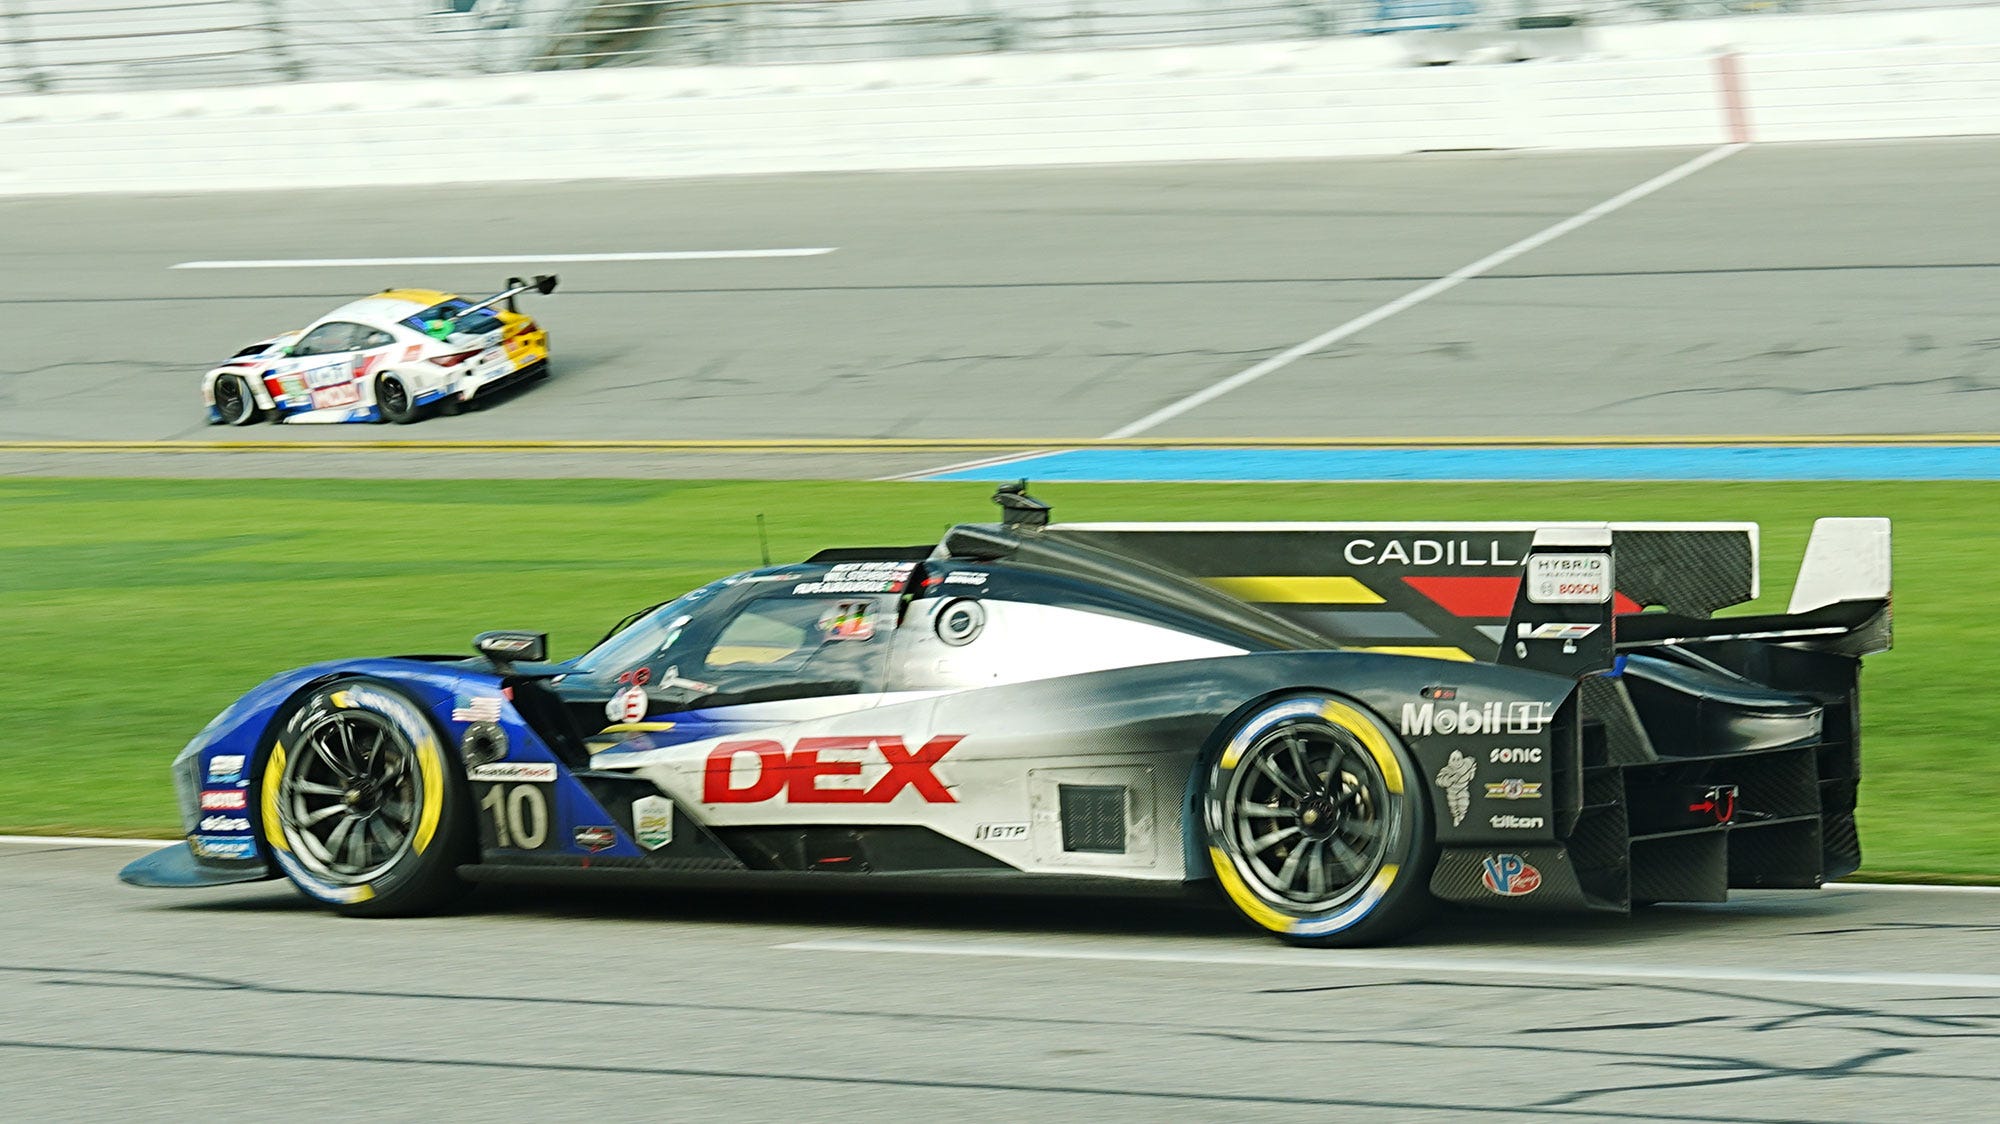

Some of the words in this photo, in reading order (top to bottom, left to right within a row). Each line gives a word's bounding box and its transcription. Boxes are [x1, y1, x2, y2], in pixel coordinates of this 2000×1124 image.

[1343, 539, 1530, 566] CADILL
[1559, 583, 1599, 595] BOSCH
[1400, 701, 1503, 736] Mobil
[702, 734, 967, 804] DEX
[480, 783, 548, 850] 10
[1489, 814, 1544, 829] tilton
[1482, 853, 1524, 892] VP
